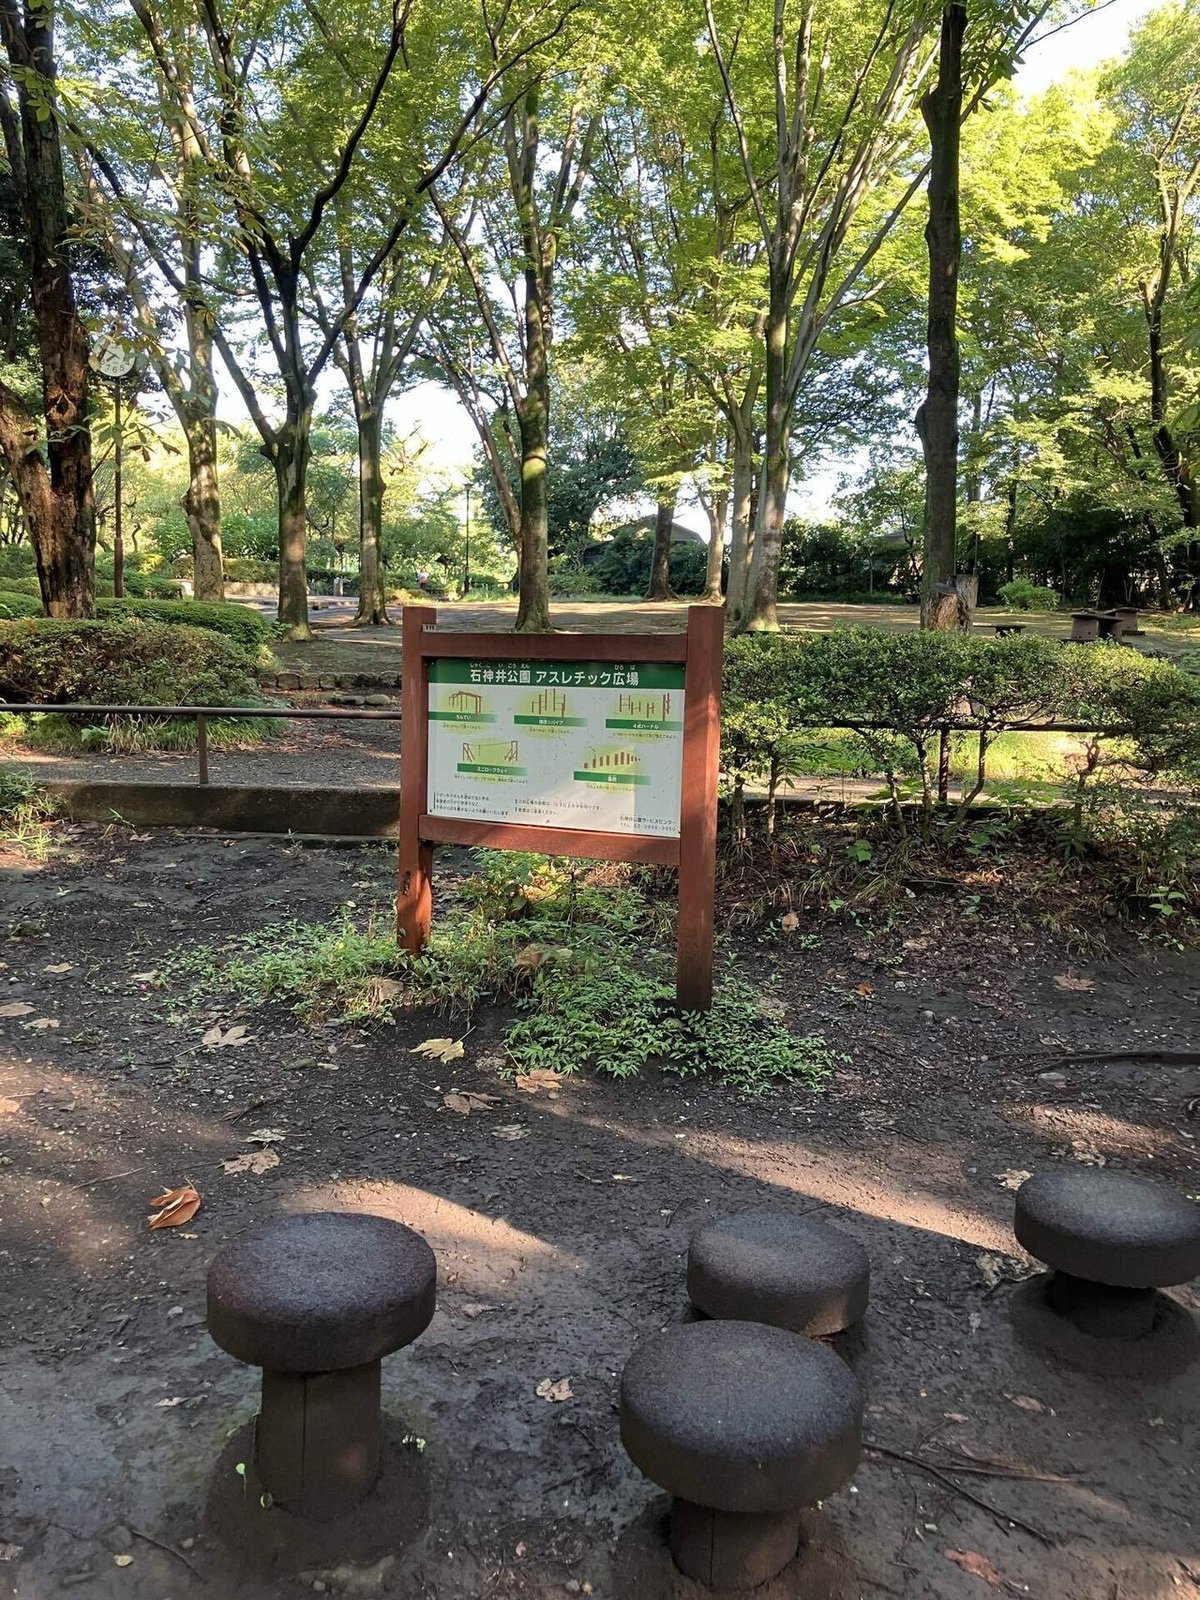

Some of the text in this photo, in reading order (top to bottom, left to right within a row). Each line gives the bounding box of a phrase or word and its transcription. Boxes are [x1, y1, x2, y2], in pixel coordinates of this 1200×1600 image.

[470, 669, 639, 686] 石神井公園 アスレチック広場
